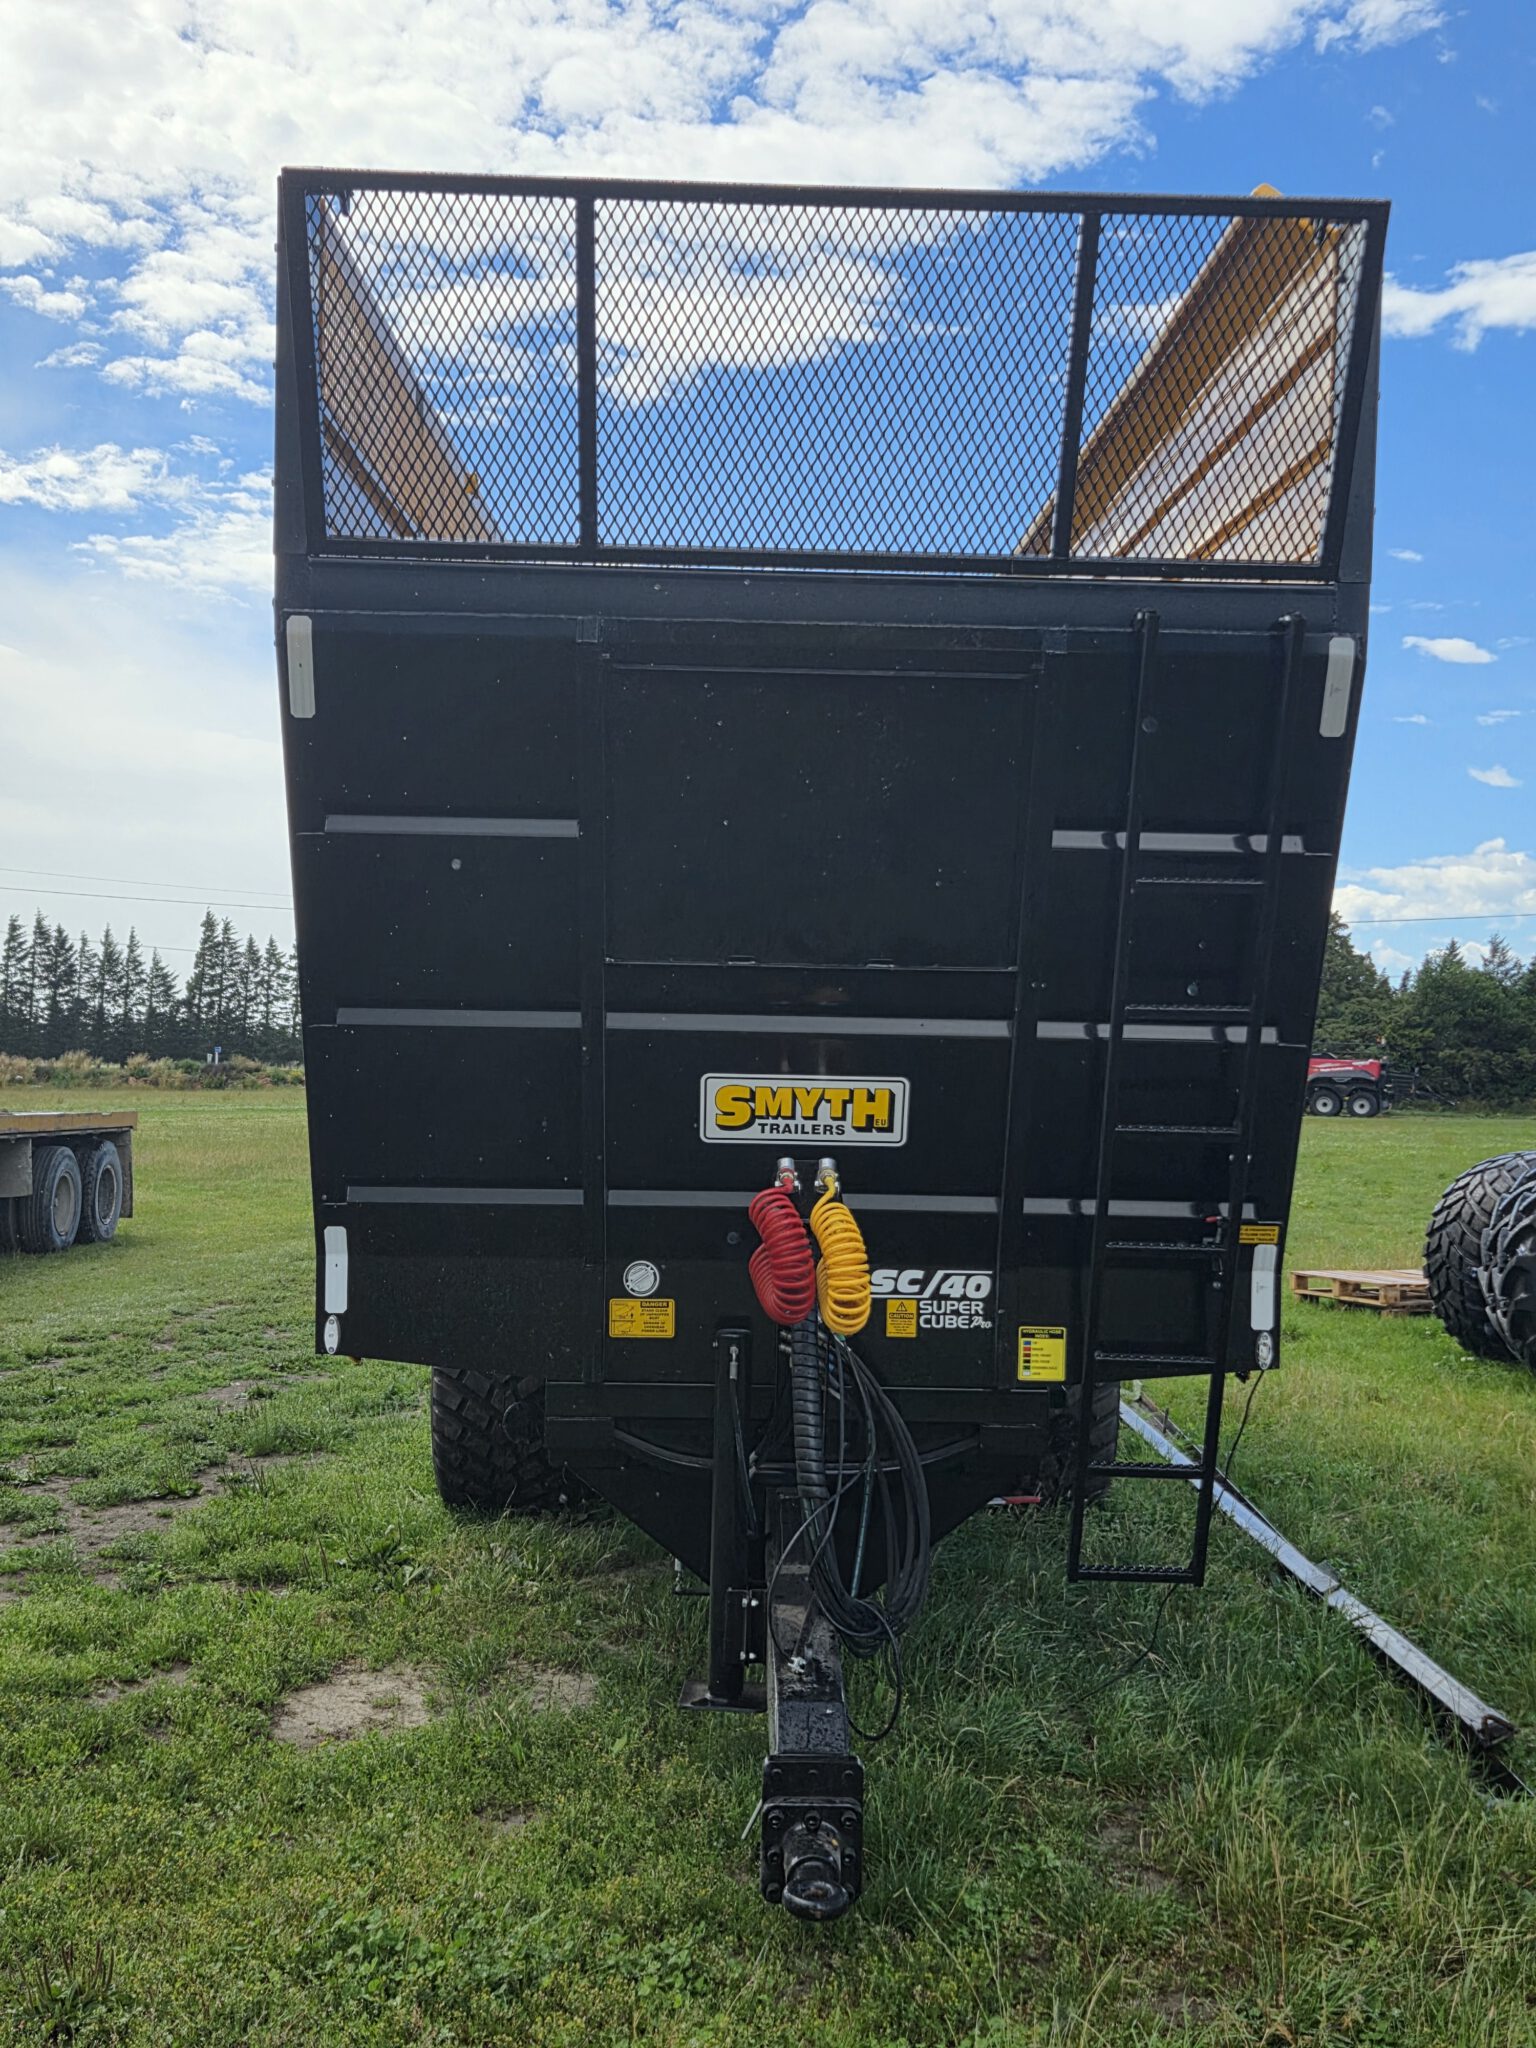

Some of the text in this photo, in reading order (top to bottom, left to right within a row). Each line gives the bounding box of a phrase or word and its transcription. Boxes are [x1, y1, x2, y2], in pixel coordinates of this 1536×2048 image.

[715, 1084, 895, 1133] SMYTH
[758, 1122, 845, 1136] TRAILERS
[874, 1118, 887, 1127] EU
[919, 1300, 984, 1315] SUPER
[919, 1315, 970, 1329] CUBE
[970, 1315, 993, 1329] Pro
